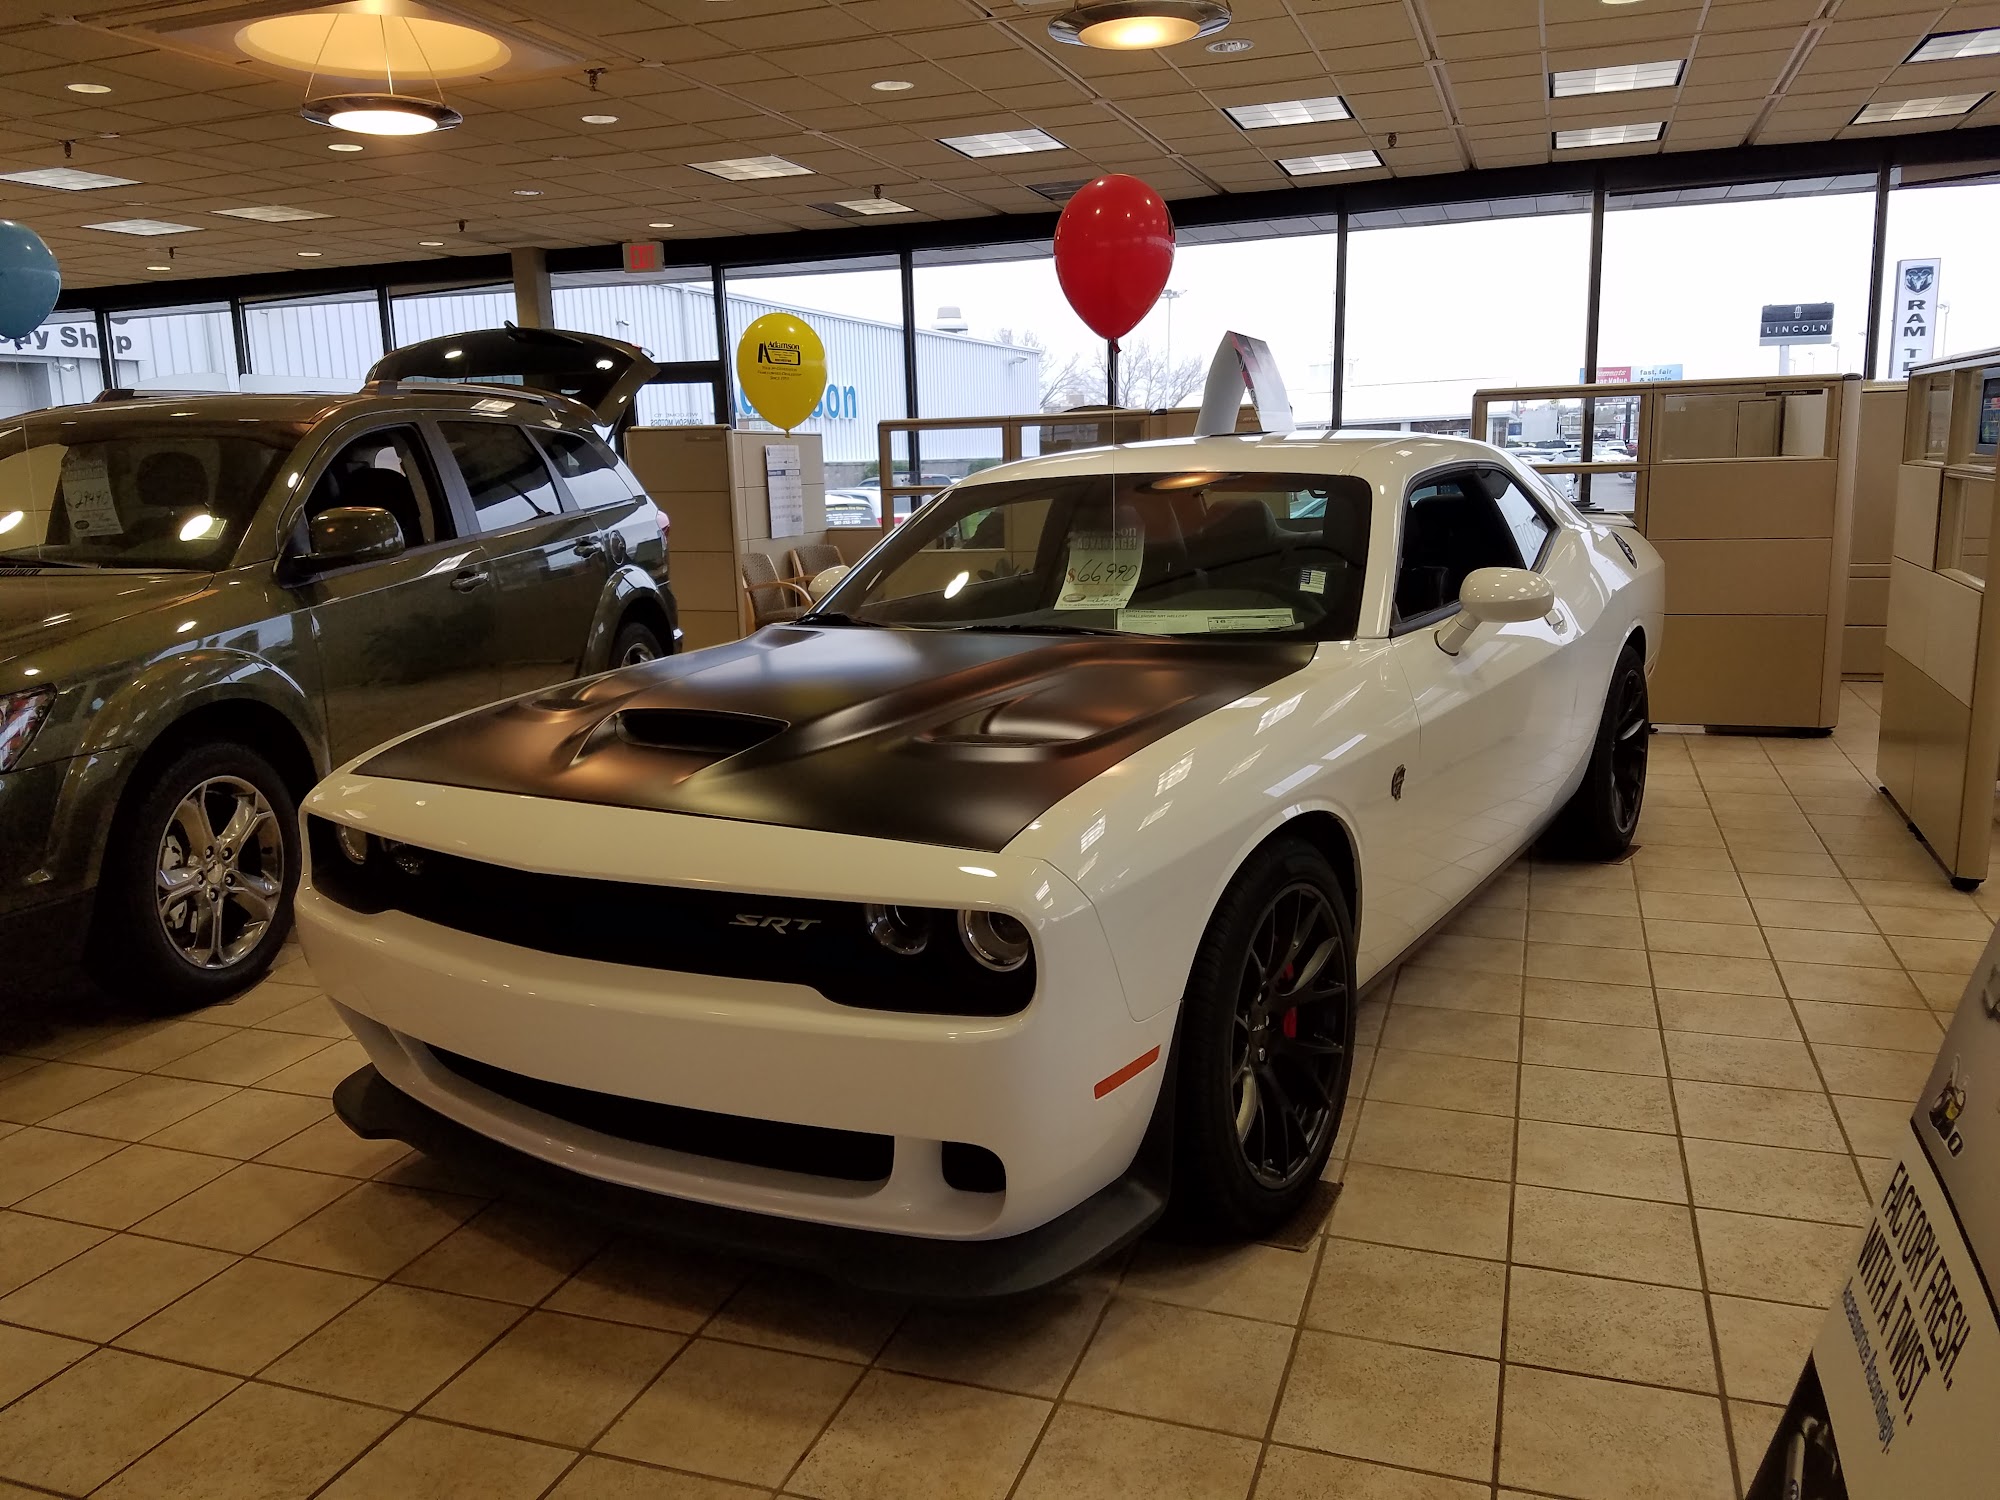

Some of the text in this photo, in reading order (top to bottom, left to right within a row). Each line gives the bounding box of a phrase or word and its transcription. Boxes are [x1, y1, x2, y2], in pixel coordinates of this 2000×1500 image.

[630, 245, 655, 269] EXIT
[1766, 324, 1827, 334] LINCOLN
[1903, 299, 1926, 337] RAM
[60, 326, 132, 354] Shp
[767, 340, 799, 350] Adamson
[728, 913, 822, 934] SRT
[1880, 1160, 1971, 1392] FACTORY FRESH.
[1857, 1216, 1931, 1427] WITH A TWIST.
